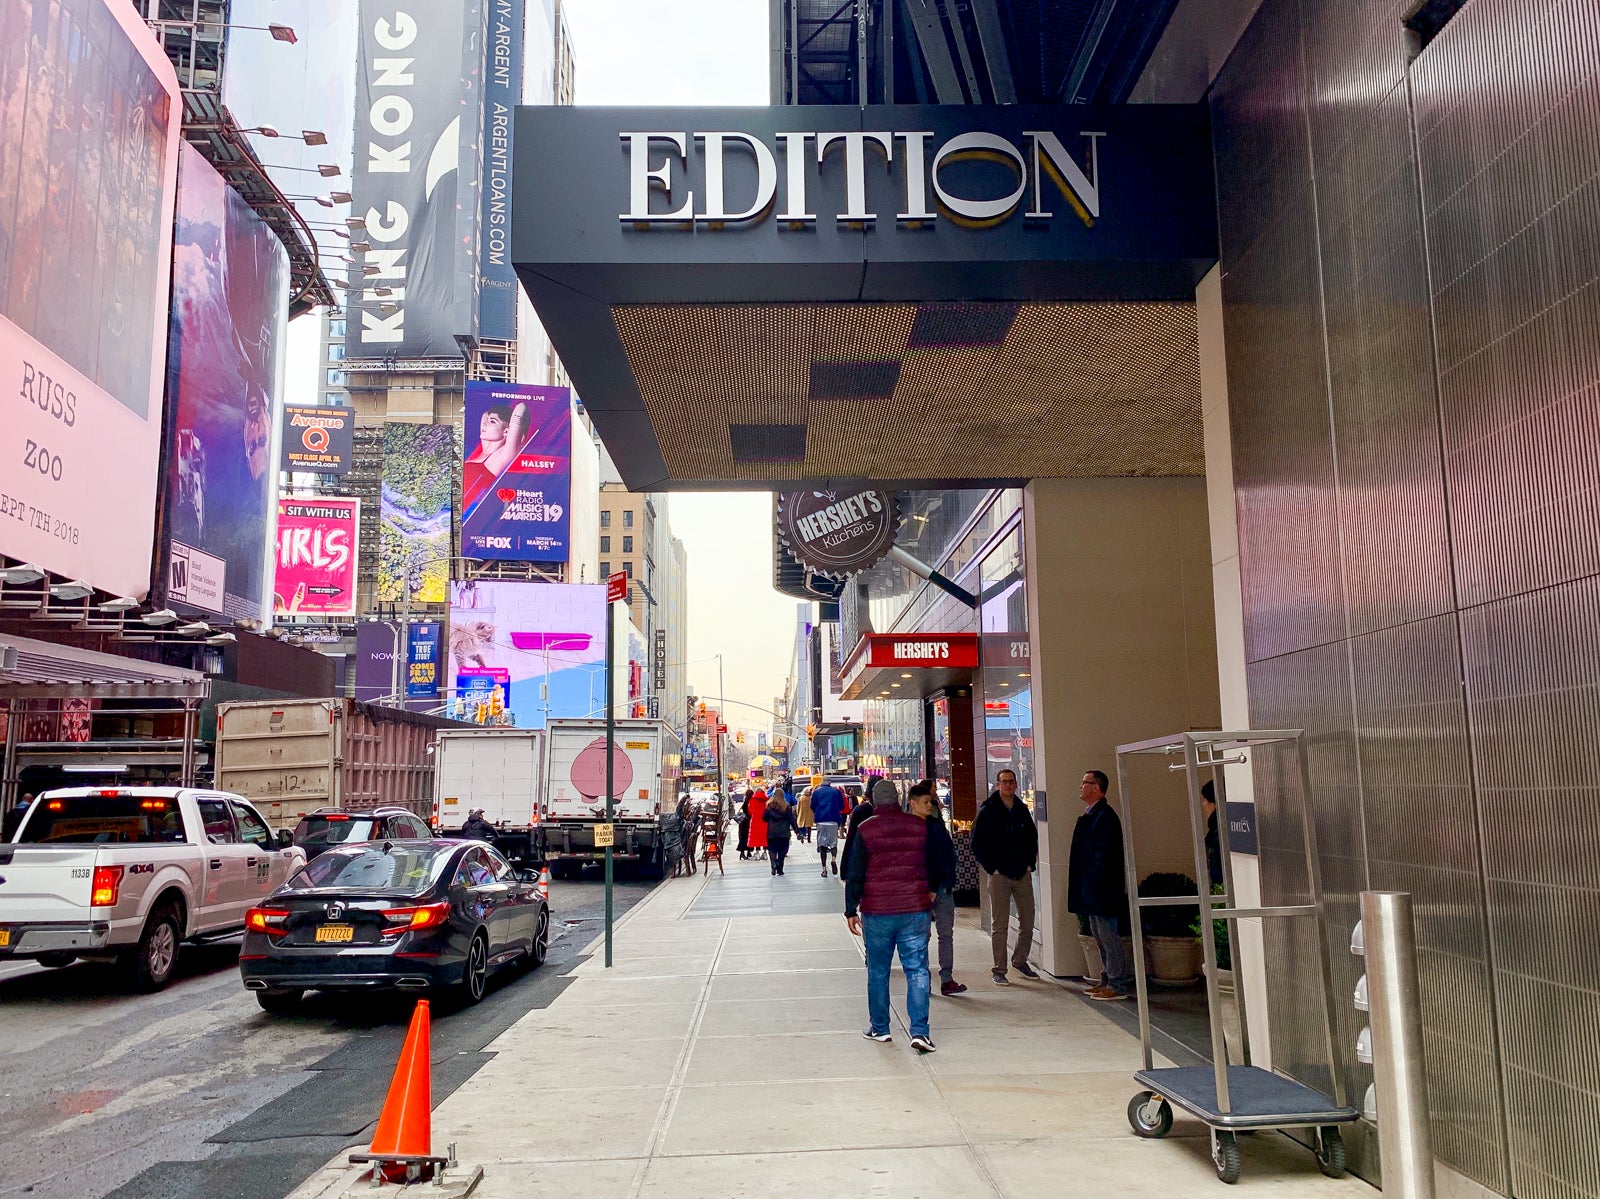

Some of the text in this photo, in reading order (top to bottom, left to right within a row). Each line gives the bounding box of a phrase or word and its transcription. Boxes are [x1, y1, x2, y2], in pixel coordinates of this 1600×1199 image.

[361, 11, 418, 343] KING KONG
[489, 102, 509, 265] ARGENTLOANS.COM
[618, 131, 1107, 222] EDITION
[20, 360, 77, 427] RUSS
[491, 392, 532, 400] PERFORMING
[290, 413, 344, 429] Avenue
[302, 426, 330, 453] Q
[24, 438, 63, 482] ZOO
[292, 460, 338, 468] AvenueQ.com
[521, 460, 555, 468] HALSEY
[516, 489, 543, 498] iHeart
[0, 493, 80, 546] EPT 7TH 2018
[287, 506, 302, 516] SIT
[305, 507, 333, 518] WITH
[500, 511, 543, 521] AWARDS
[506, 501, 564, 522] MUSIC 19
[797, 490, 882, 543] HERSHEY'S
[486, 536, 512, 549] FOX
[822, 520, 875, 549] Kitchens
[276, 526, 350, 572] IRLS
[171, 560, 186, 589] M
[371, 652, 394, 660] NOW
[415, 645, 431, 654] TRUE
[894, 642, 949, 659] HERSHEY'S
[656, 641, 665, 688] HOTEL
[410, 676, 435, 684] AWAY
[285, 775, 301, 791] 12
[72, 868, 91, 879] 11336
